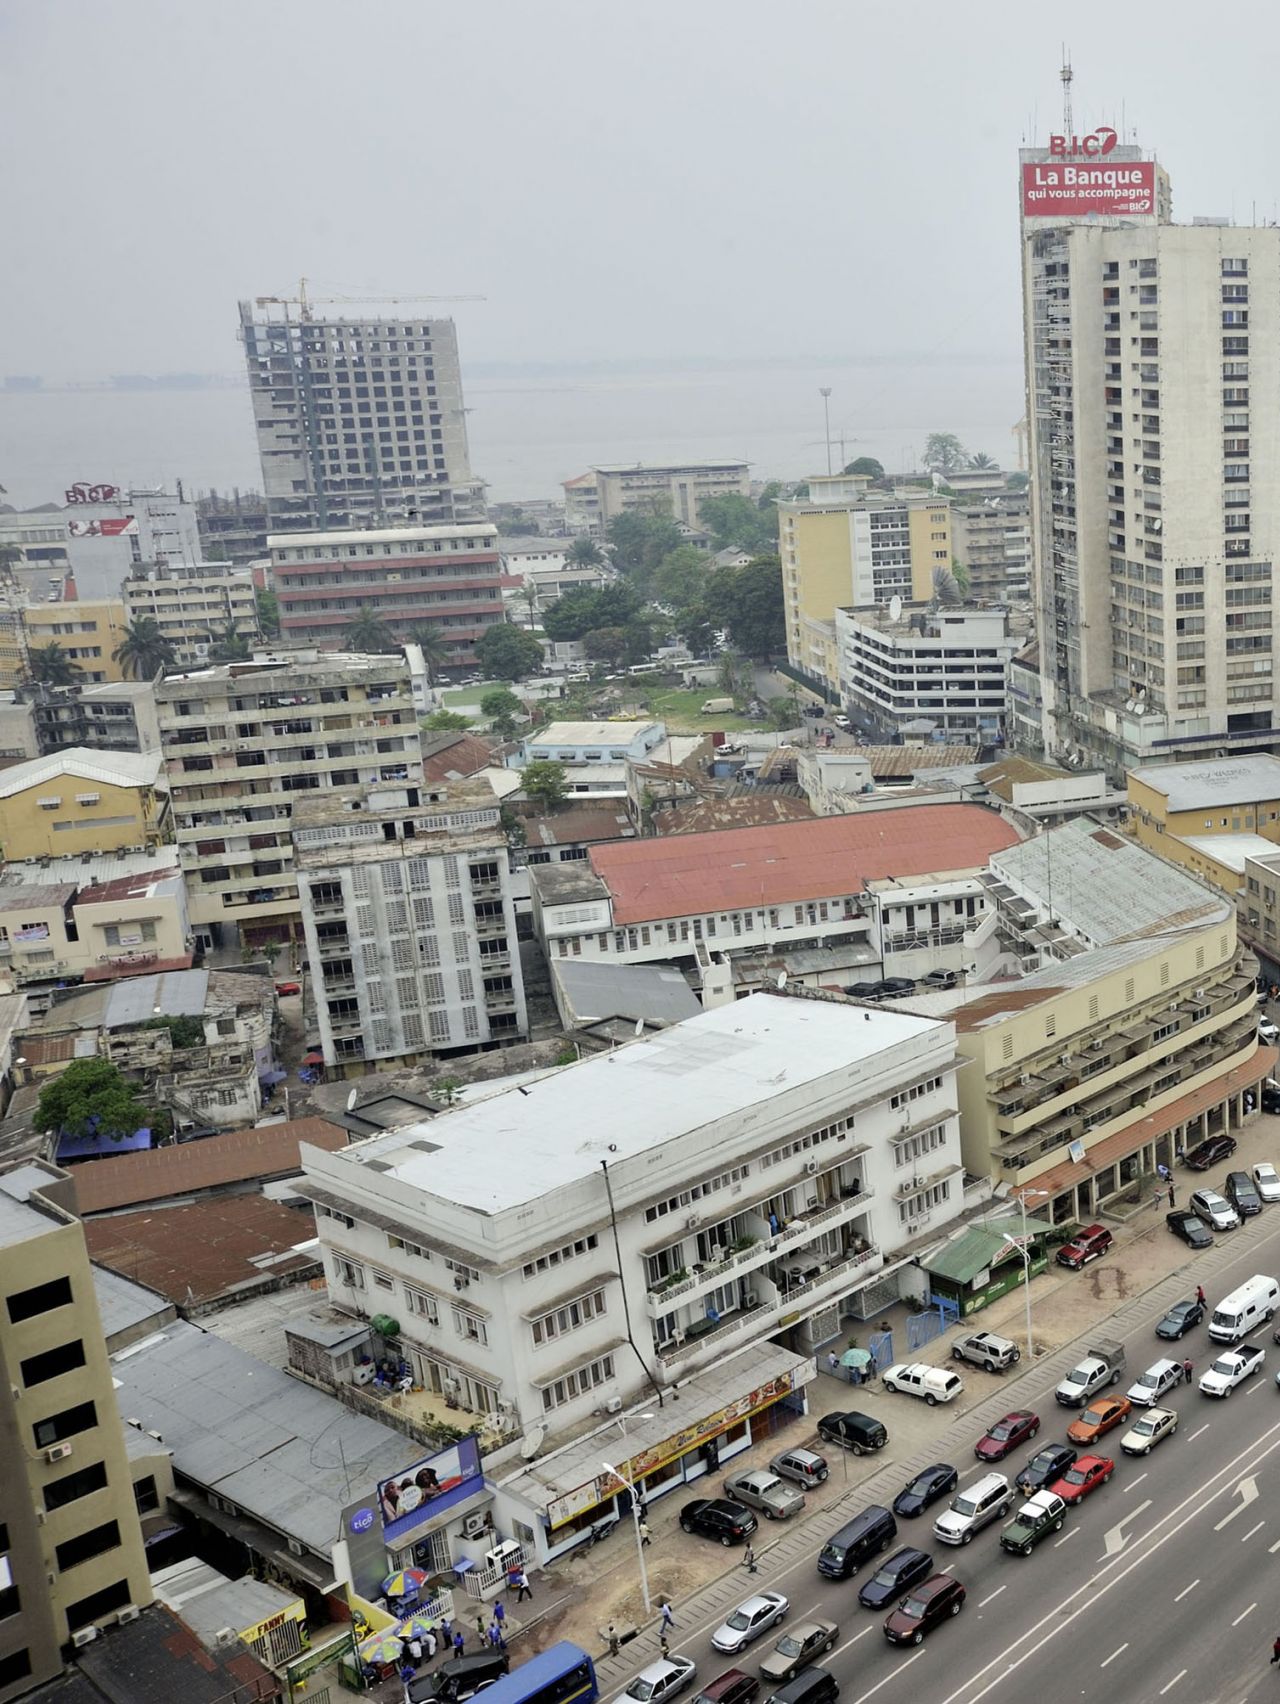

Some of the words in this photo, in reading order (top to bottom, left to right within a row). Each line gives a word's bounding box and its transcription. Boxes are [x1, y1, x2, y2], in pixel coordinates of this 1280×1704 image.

[1035, 168, 1058, 185] La
[1064, 167, 1142, 188] Banque
[1028, 188, 1046, 200] qui
[1049, 190, 1076, 198] vous
[1078, 189, 1150, 200] accompagne
[353, 1513, 373, 1529] tigo
[257, 1612, 286, 1636] FANNY
